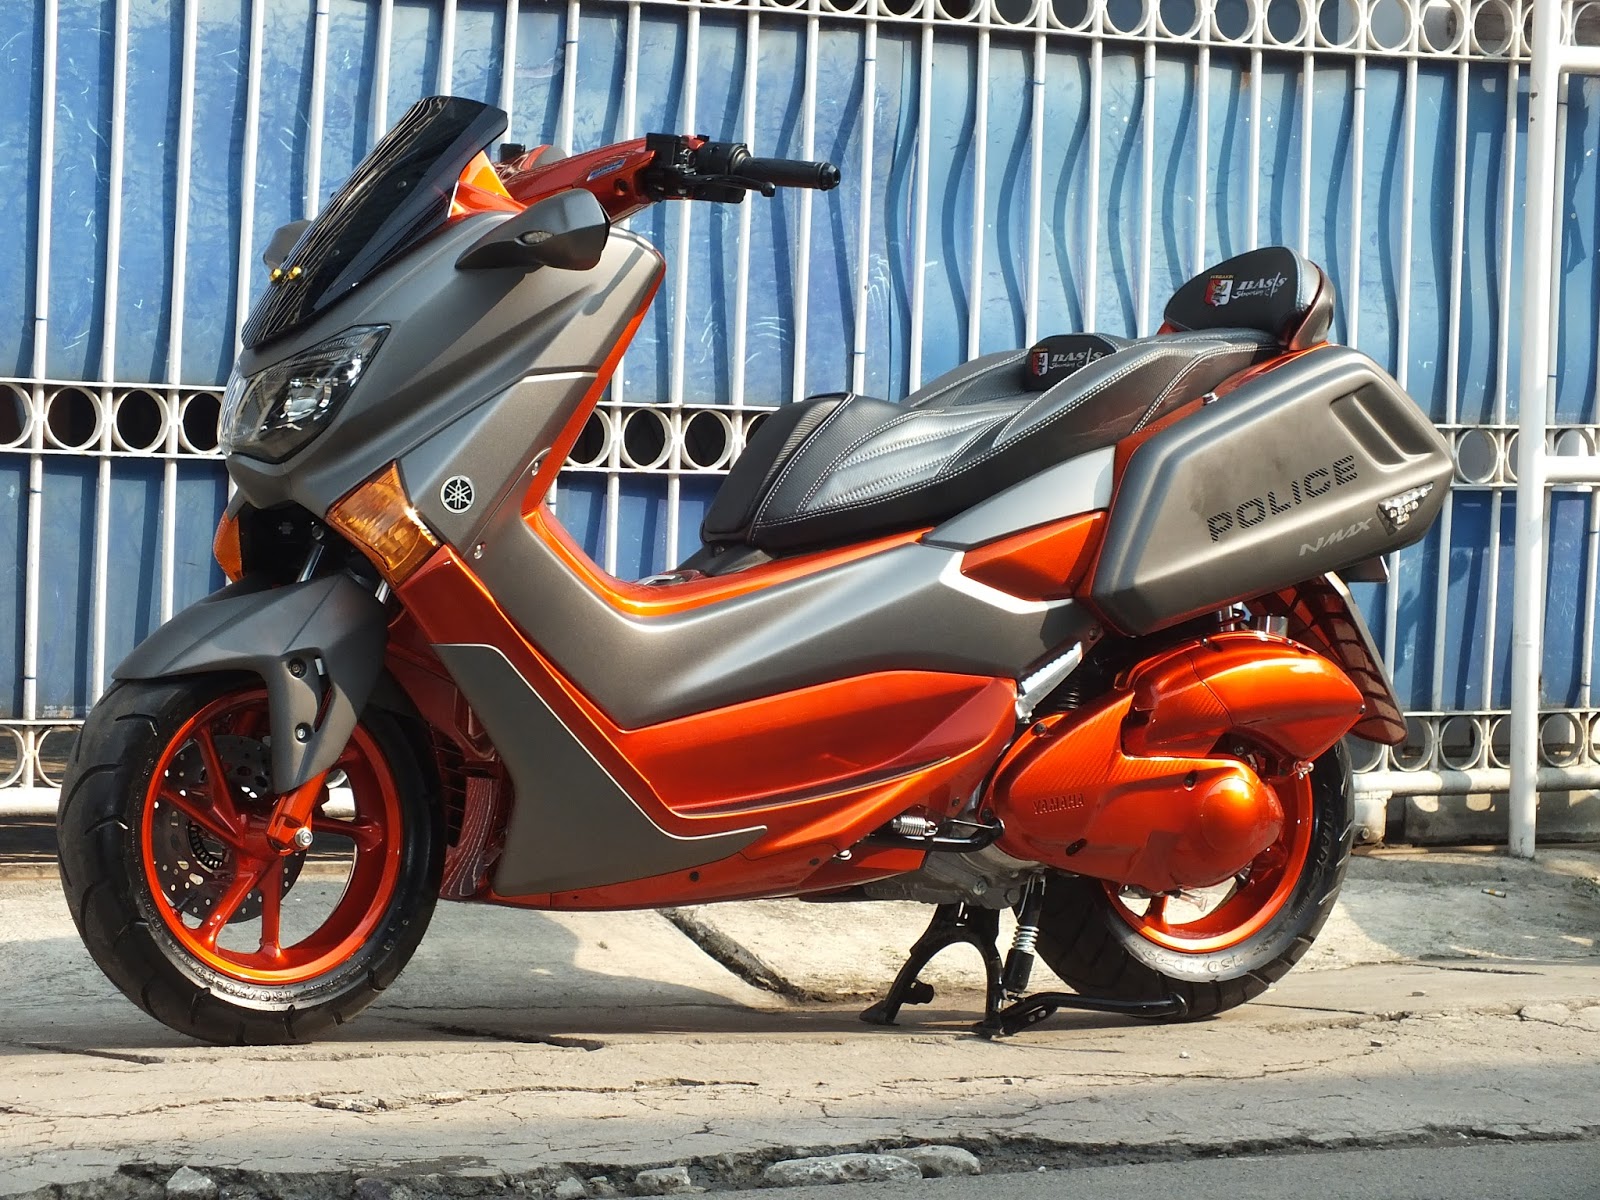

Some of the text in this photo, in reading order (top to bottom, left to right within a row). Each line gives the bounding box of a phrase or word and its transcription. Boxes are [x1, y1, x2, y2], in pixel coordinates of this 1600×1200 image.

[1207, 454, 1358, 543] POLICE
[1299, 517, 1375, 557] NMAX
[1032, 792, 1085, 815] YAMAHA
